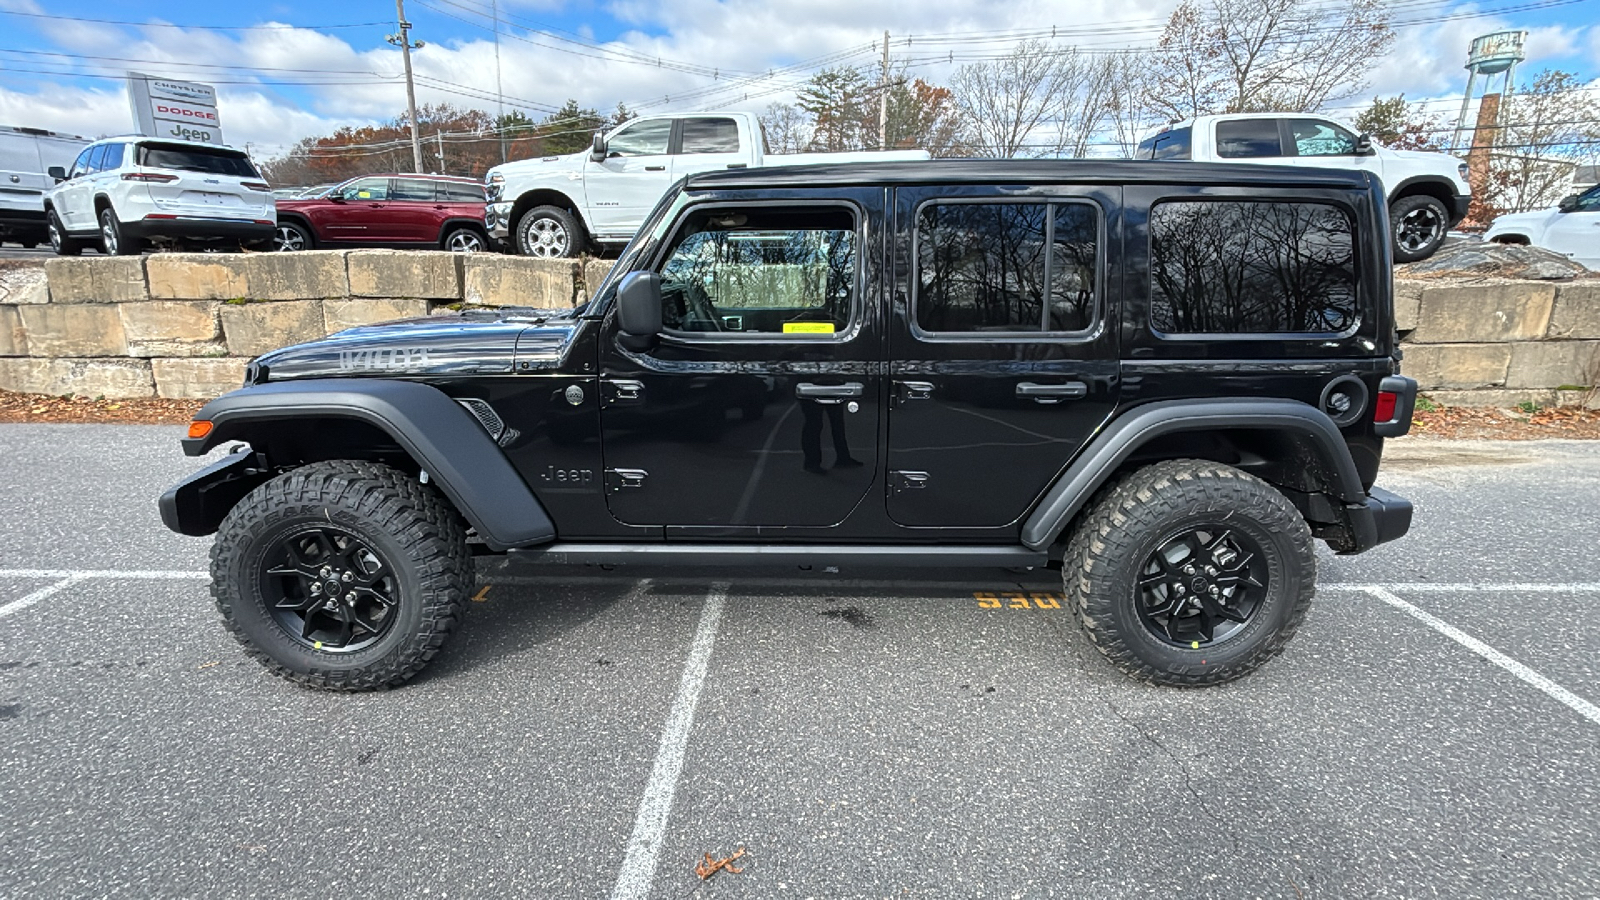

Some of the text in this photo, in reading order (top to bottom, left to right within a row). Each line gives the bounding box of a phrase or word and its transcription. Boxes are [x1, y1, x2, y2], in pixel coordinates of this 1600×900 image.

[155, 81, 210, 95] CHRYSLER
[157, 105, 216, 120] DODGE
[170, 124, 211, 142] Jeep
[541, 465, 593, 485] Jeep
